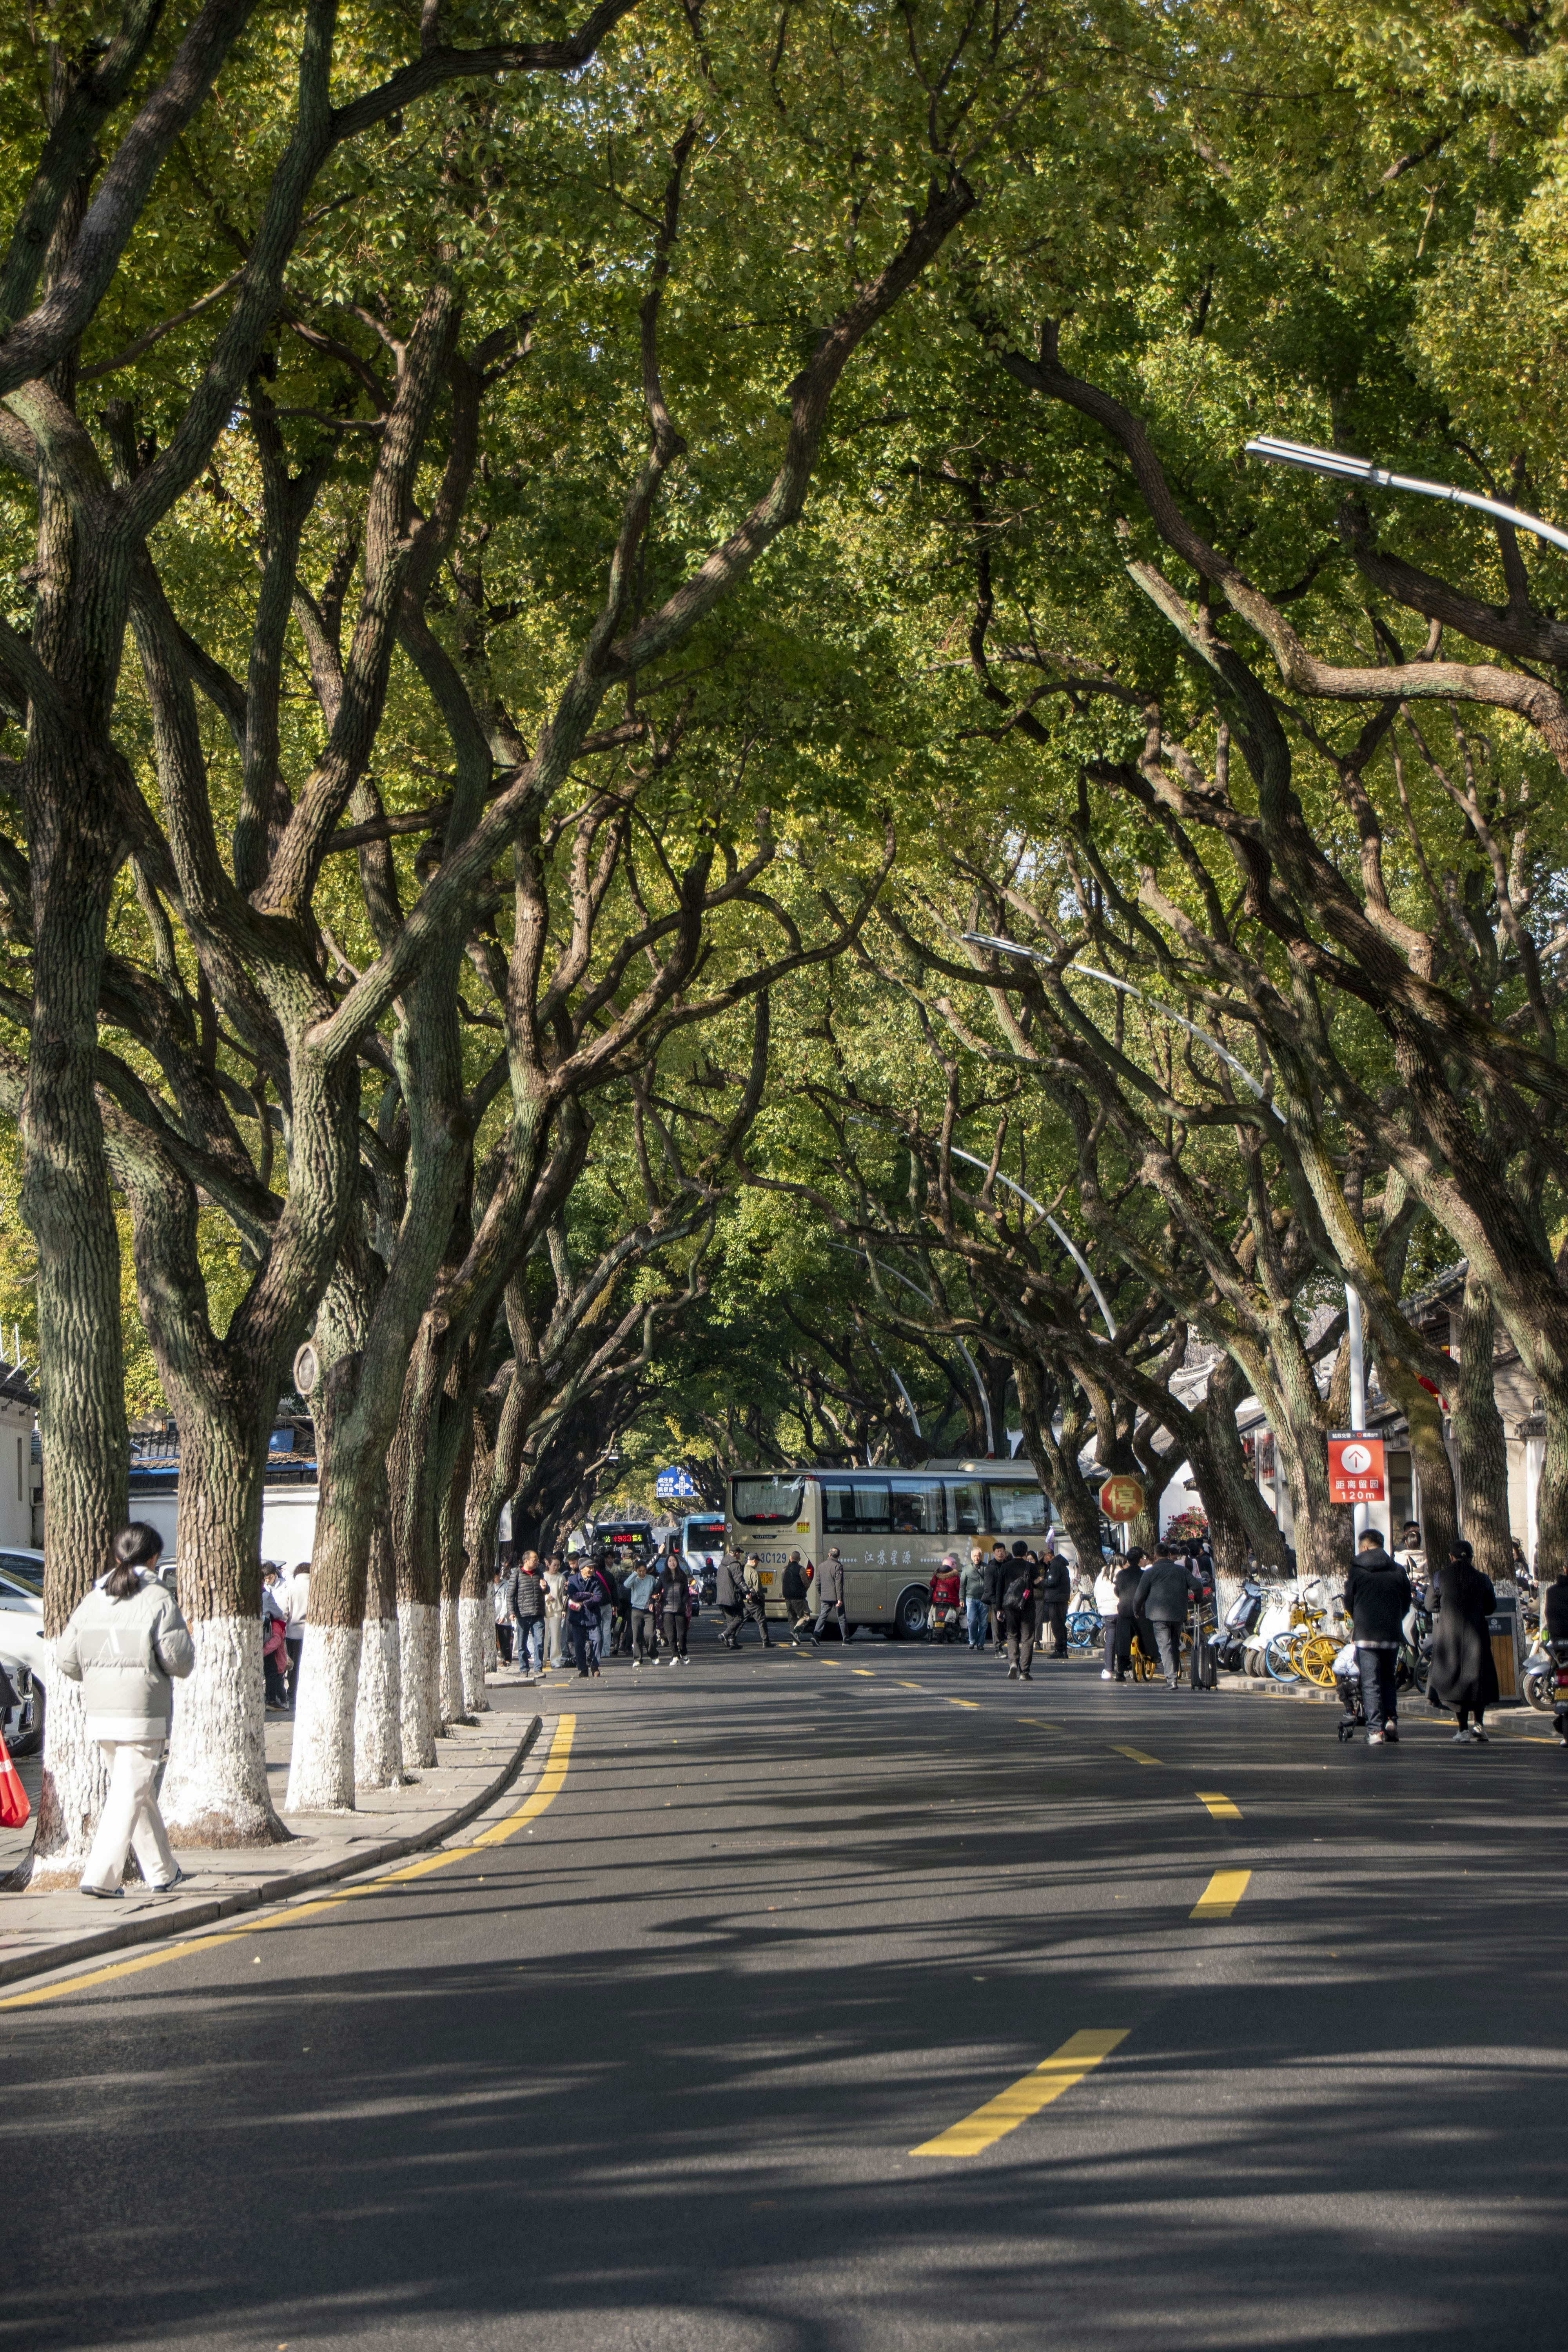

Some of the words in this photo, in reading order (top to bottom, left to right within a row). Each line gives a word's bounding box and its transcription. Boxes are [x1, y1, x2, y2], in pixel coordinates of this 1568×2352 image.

[1336, 1479, 1379, 1489] 距离留园
[1108, 1484, 1136, 1514] 停
[1341, 1491, 1374, 1499] 120m
[864, 1549, 911, 1566] 江苏星源
